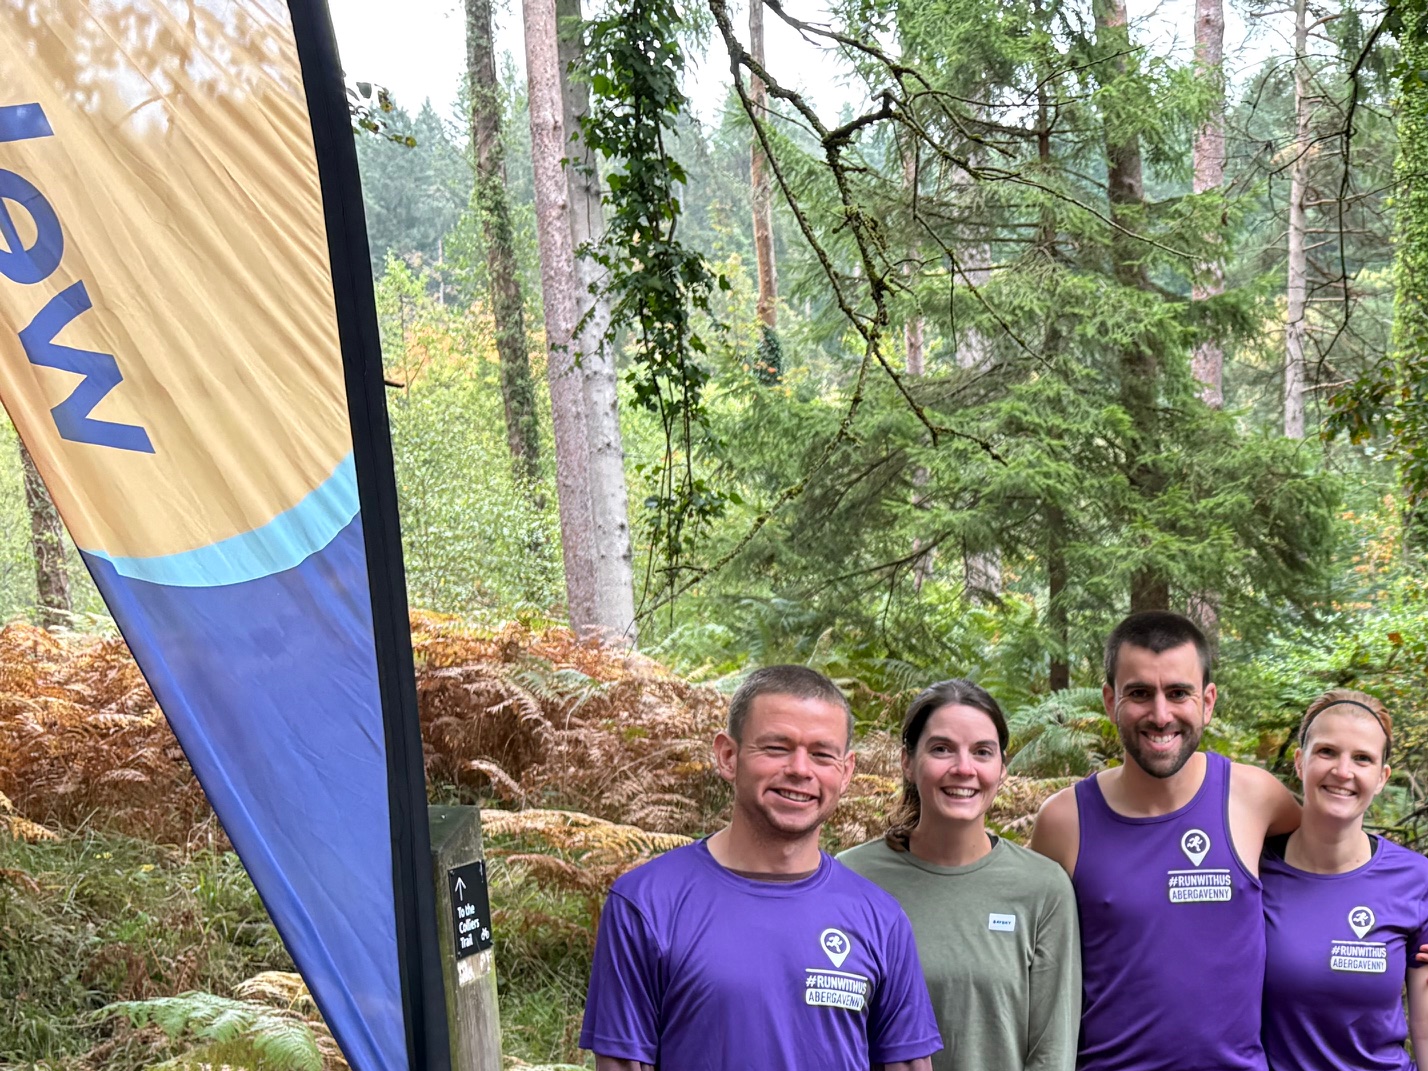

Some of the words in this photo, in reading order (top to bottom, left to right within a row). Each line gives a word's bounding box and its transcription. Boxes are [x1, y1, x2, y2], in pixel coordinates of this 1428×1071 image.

[1169, 874, 1231, 887] #RUNWITHUS
[1172, 889, 1229, 899] ABERGAVENNY
[457, 907, 465, 919] To
[465, 903, 475, 916] the
[459, 918, 480, 934] Colliers
[460, 933, 474, 949] Trail
[1331, 945, 1386, 957] #RUNWITHUS
[1333, 958, 1384, 970] ABERGAVENNY
[805, 975, 867, 995] #RUNWITHUS
